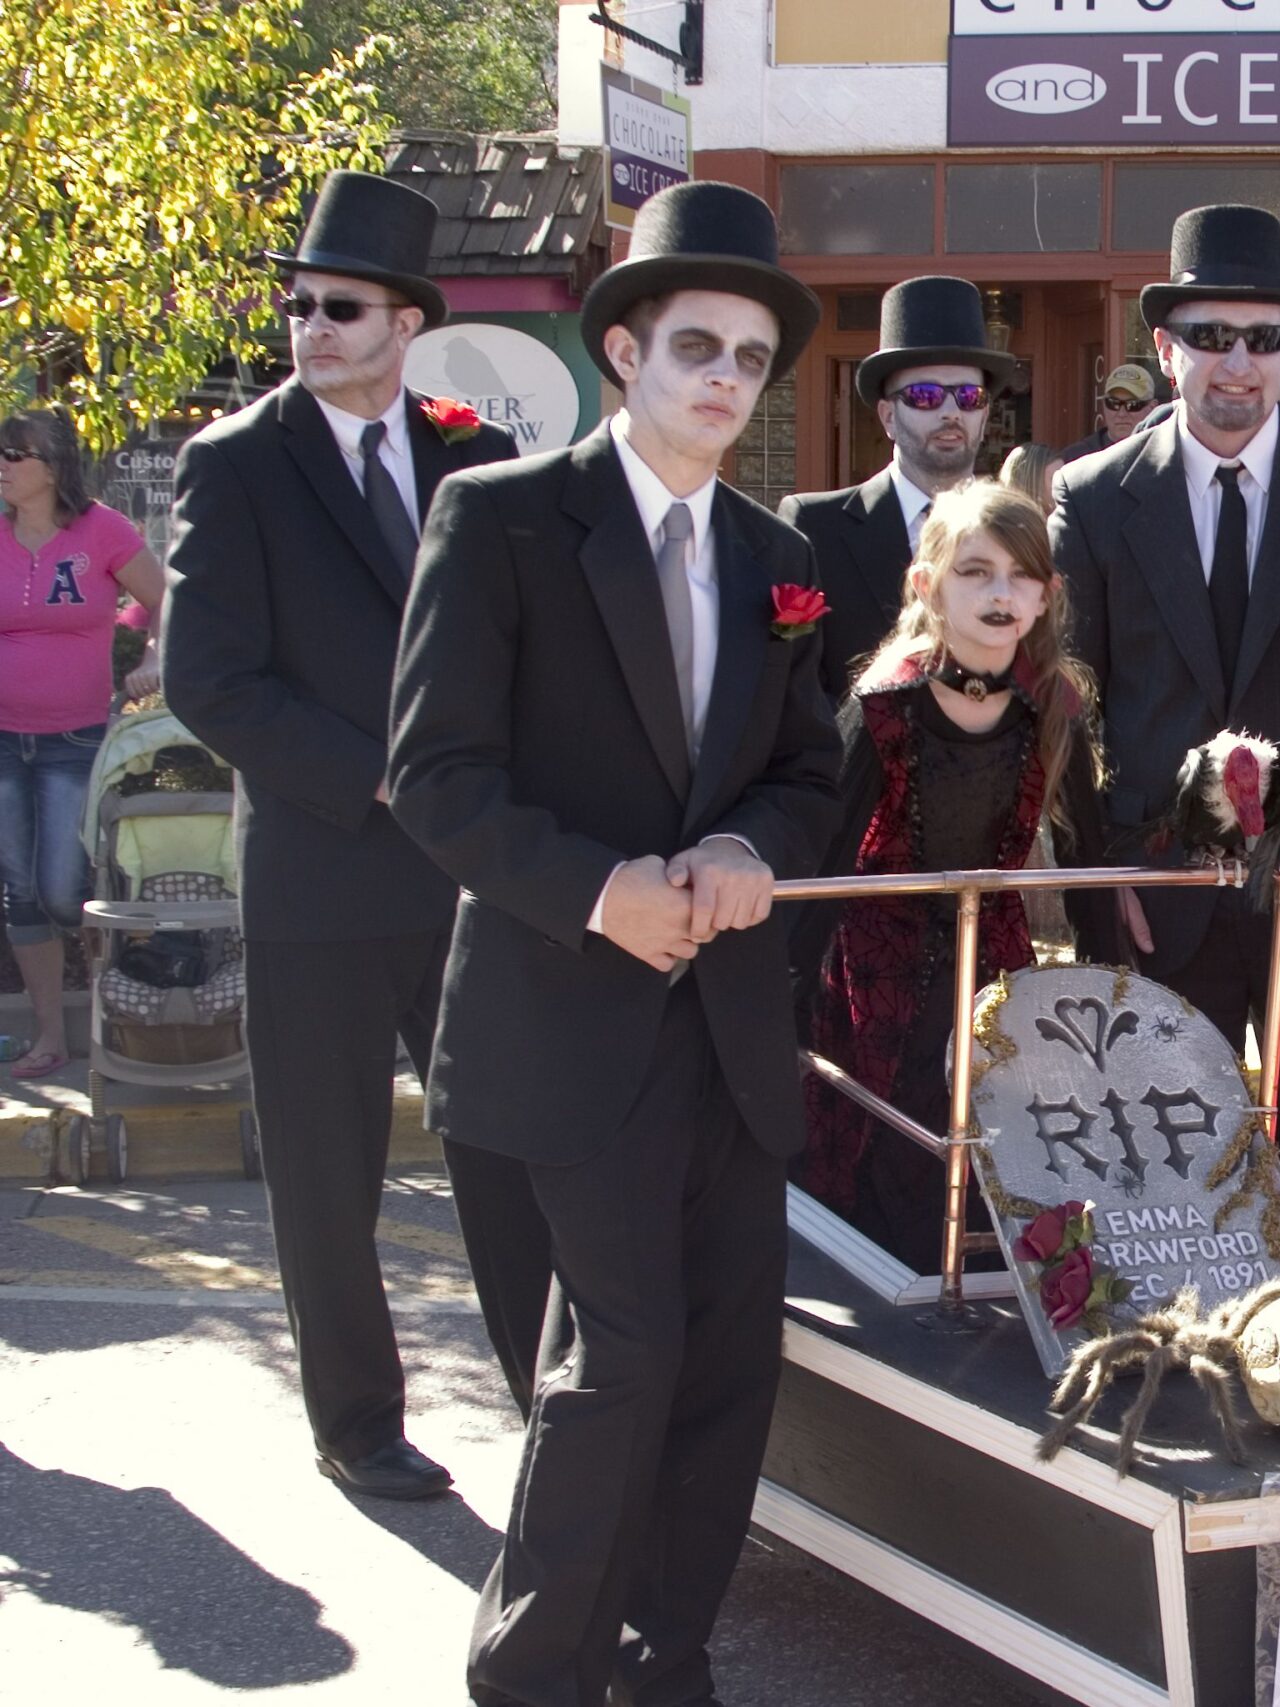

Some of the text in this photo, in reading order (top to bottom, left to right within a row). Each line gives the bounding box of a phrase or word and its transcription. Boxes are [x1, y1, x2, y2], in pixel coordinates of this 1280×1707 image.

[994, 71, 1096, 102] and
[1121, 51, 1279, 126] ICE
[613, 113, 685, 165] CHOCOLATE
[628, 163, 649, 196] ICE
[115, 451, 175, 471] Custo
[45, 559, 86, 605] A
[1025, 1085, 1222, 1185] RIP
[1105, 1203, 1208, 1236] EMMA
[1207, 1260, 1270, 1290] 1891
